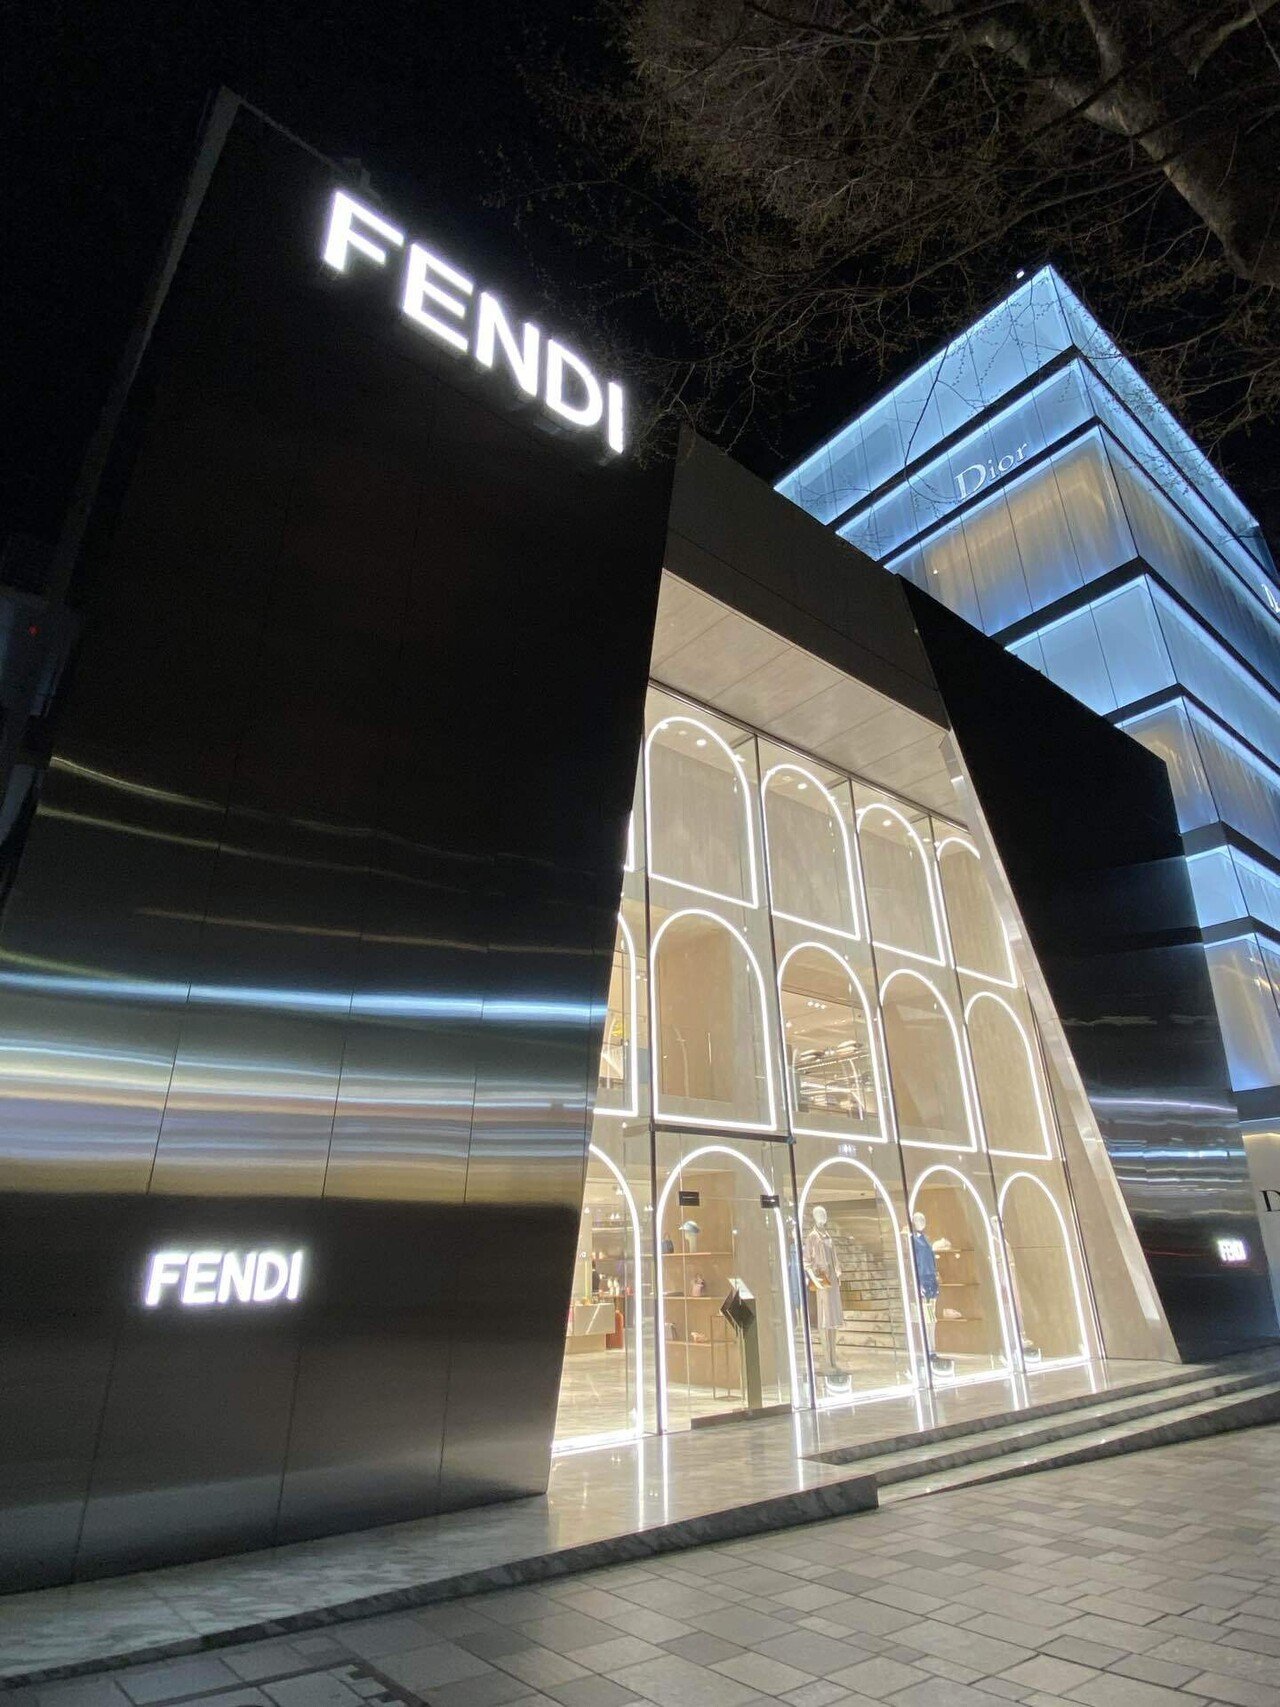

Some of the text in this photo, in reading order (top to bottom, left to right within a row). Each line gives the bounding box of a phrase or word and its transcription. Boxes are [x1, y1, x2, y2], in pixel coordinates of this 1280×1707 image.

[323, 190, 625, 454] FENDI
[954, 443, 1027, 500] Dior
[145, 1250, 304, 1306] FENDI
